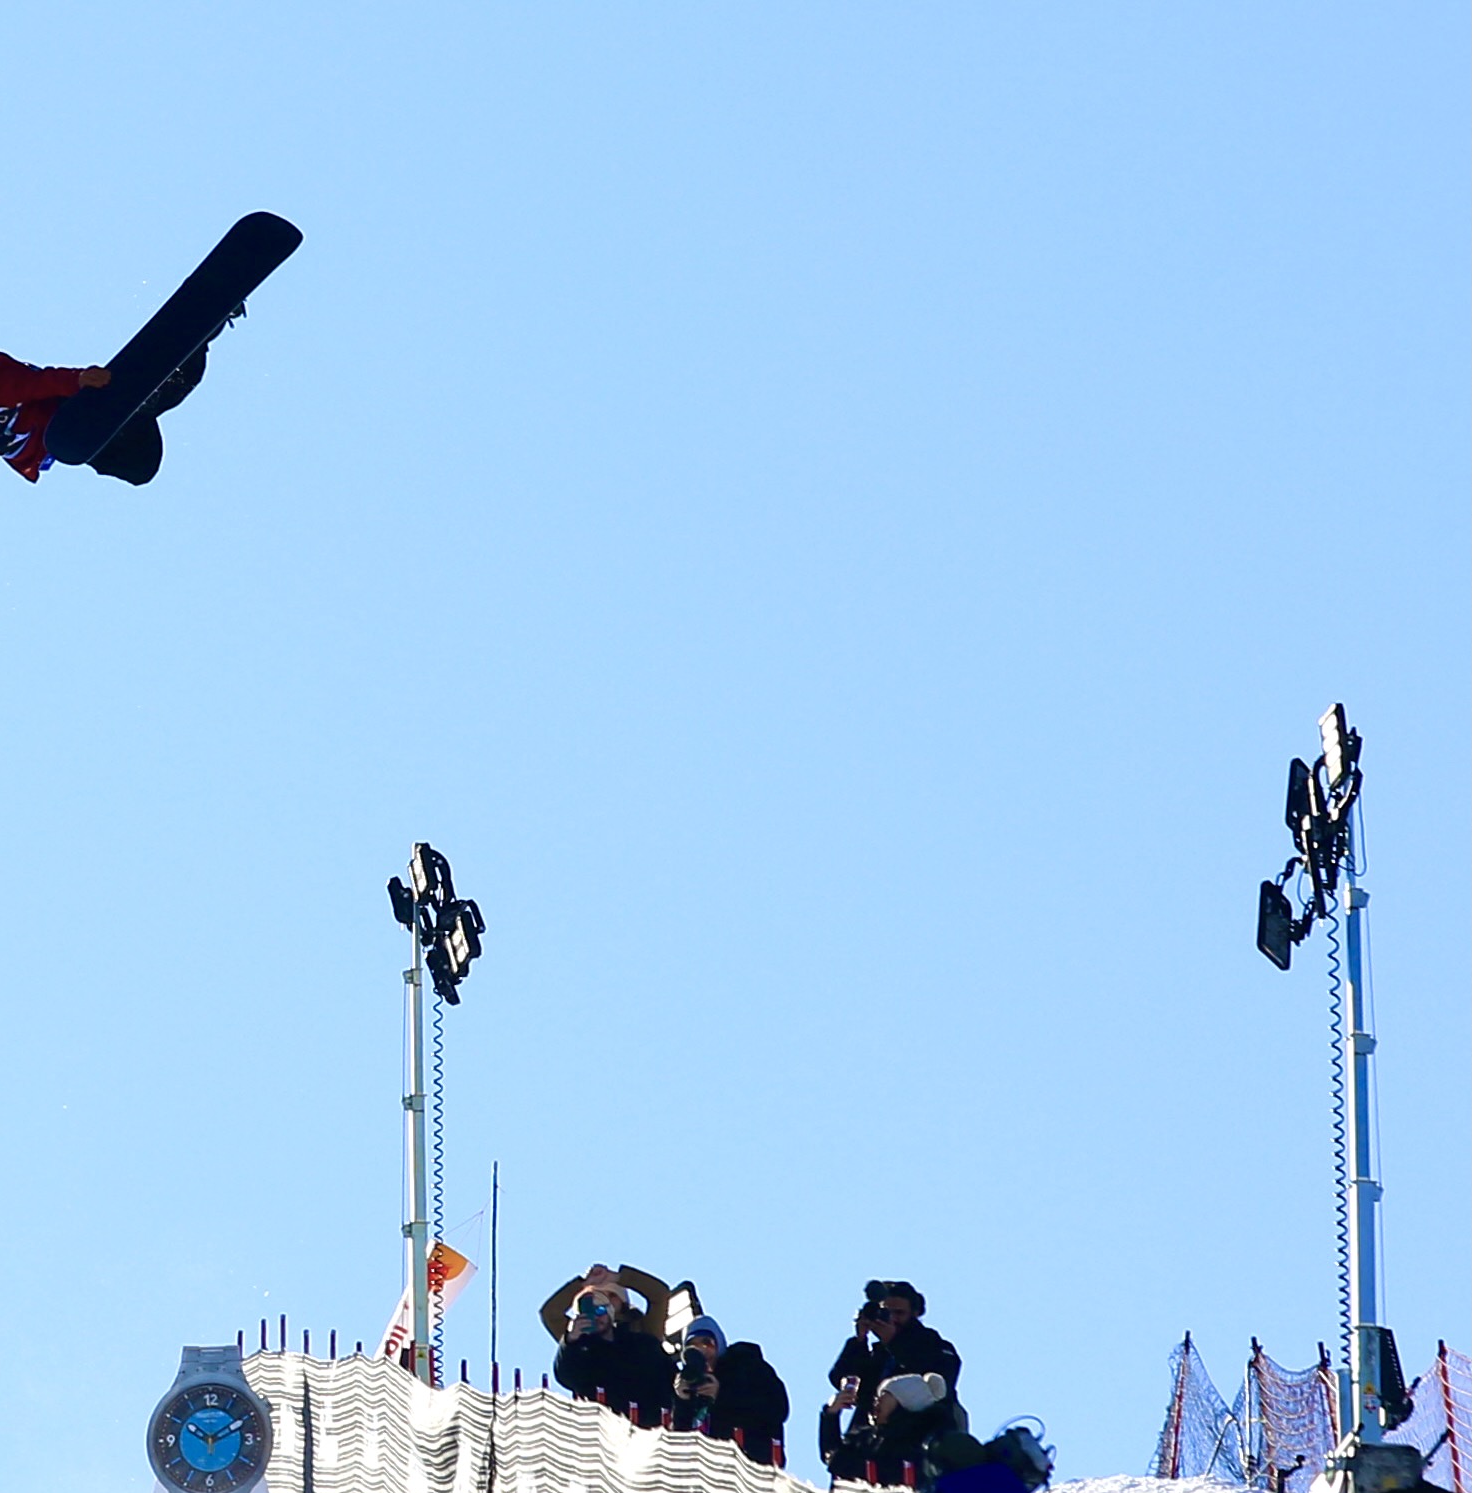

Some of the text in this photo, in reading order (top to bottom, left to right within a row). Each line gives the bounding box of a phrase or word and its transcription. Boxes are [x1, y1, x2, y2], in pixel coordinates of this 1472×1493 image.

[203, 1393, 219, 1406] 12
[166, 1434, 175, 1447] 9
[244, 1433, 253, 1445] 3
[205, 1473, 214, 1486] 6
